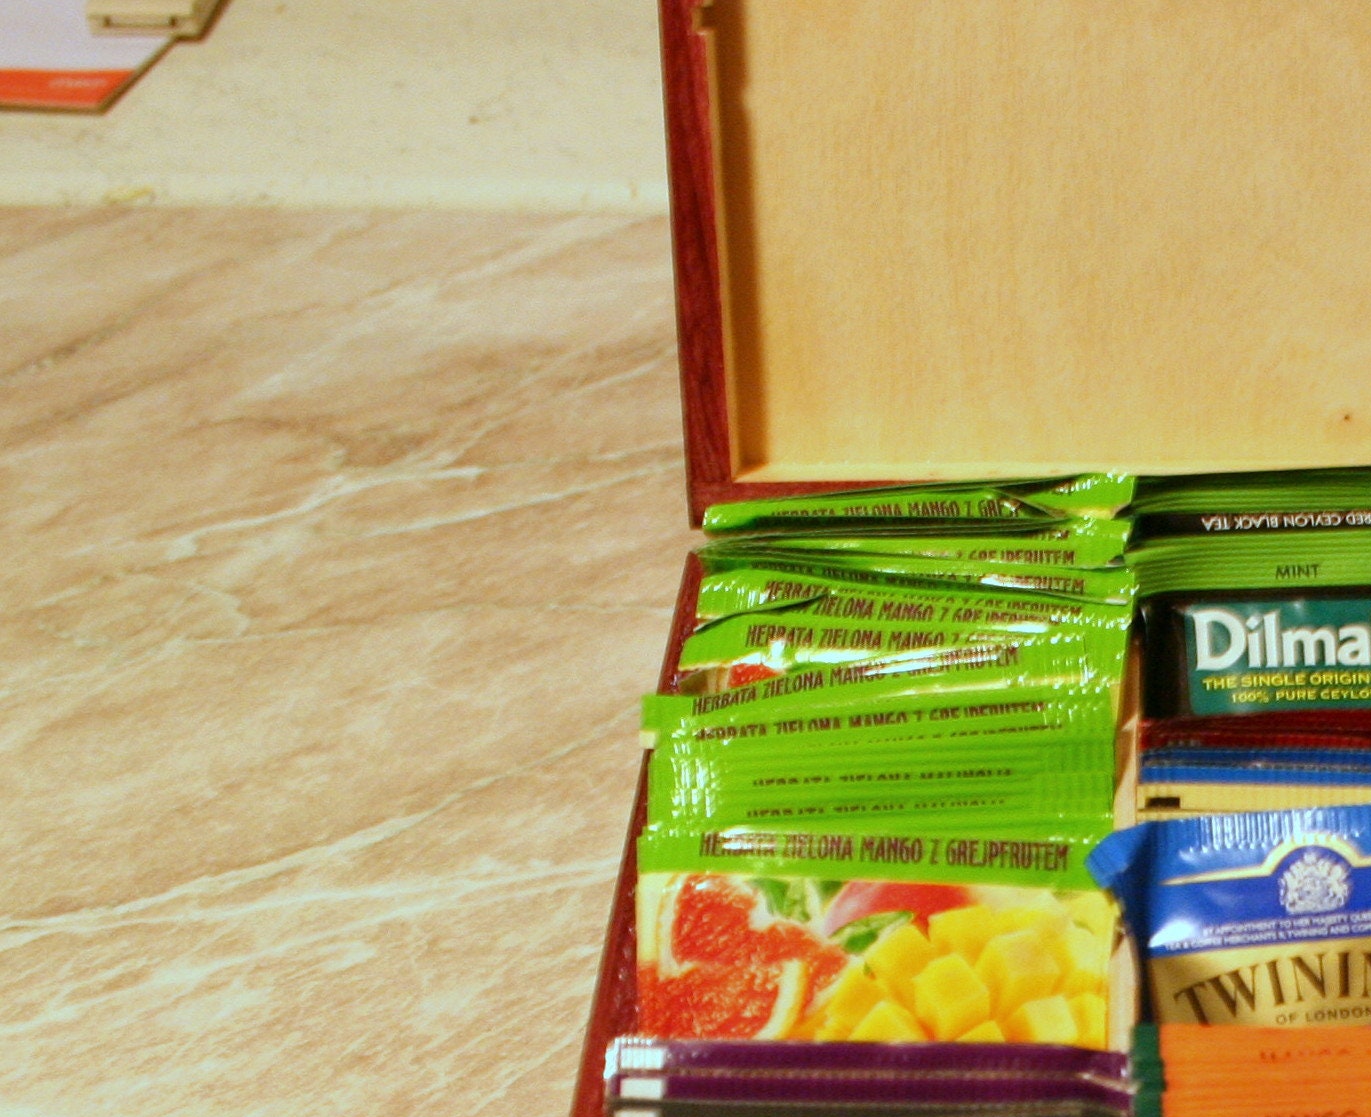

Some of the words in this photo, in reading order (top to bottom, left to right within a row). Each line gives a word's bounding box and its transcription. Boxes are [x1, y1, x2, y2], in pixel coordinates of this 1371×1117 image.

[1201, 516, 1230, 532] TEA
[1233, 514, 1280, 531] BLACK
[1283, 513, 1341, 528] CEYLON
[1275, 563, 1320, 580] MINT
[1203, 675, 1238, 691] THE
[1239, 673, 1306, 688] SINGLE
[1309, 671, 1370, 687] ORIGIN
[692, 686, 757, 717] HERBATA
[763, 670, 824, 699] ZIELONA
[1274, 688, 1318, 702] PURE
[782, 833, 853, 861] ZIELONA
[860, 836, 923, 864] MANGO
[945, 838, 1070, 872] GREJPFRUTEM
[1276, 1012, 1298, 1025] OF
